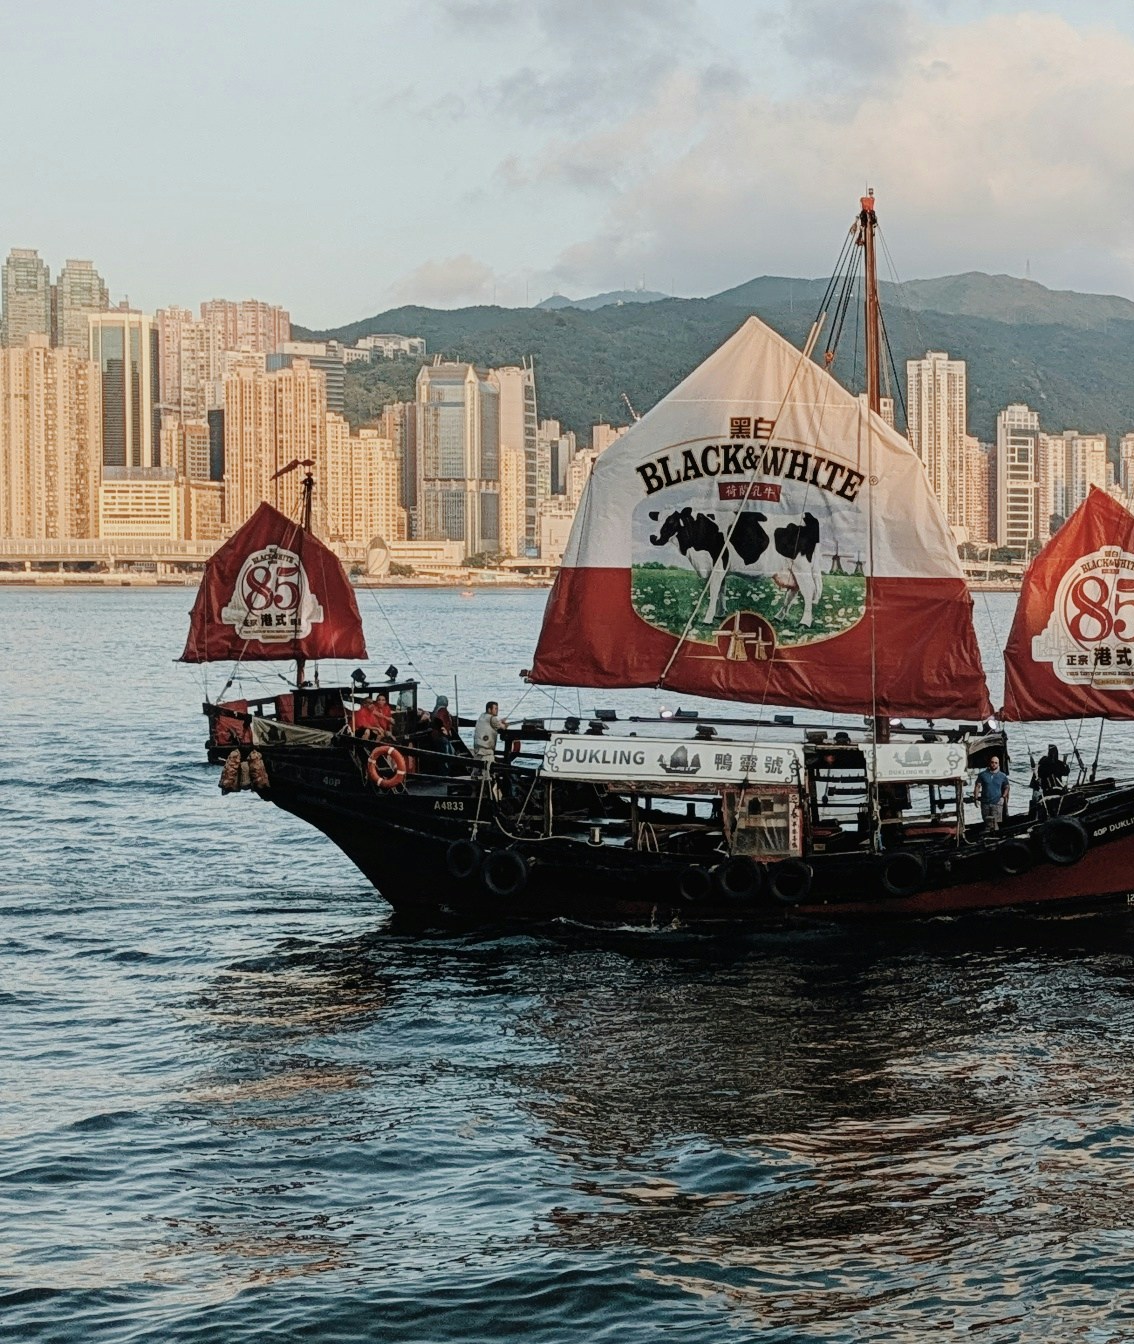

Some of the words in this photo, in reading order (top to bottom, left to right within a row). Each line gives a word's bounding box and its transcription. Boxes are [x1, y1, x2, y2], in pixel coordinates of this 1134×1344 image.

[730, 416, 777, 439] 黑白
[636, 444, 865, 502] BLACK&WHITE
[246, 565, 300, 611] 85
[562, 748, 645, 765] DUKLING
[714, 753, 783, 775] 鴨靈號
[434, 800, 464, 811] A4833
